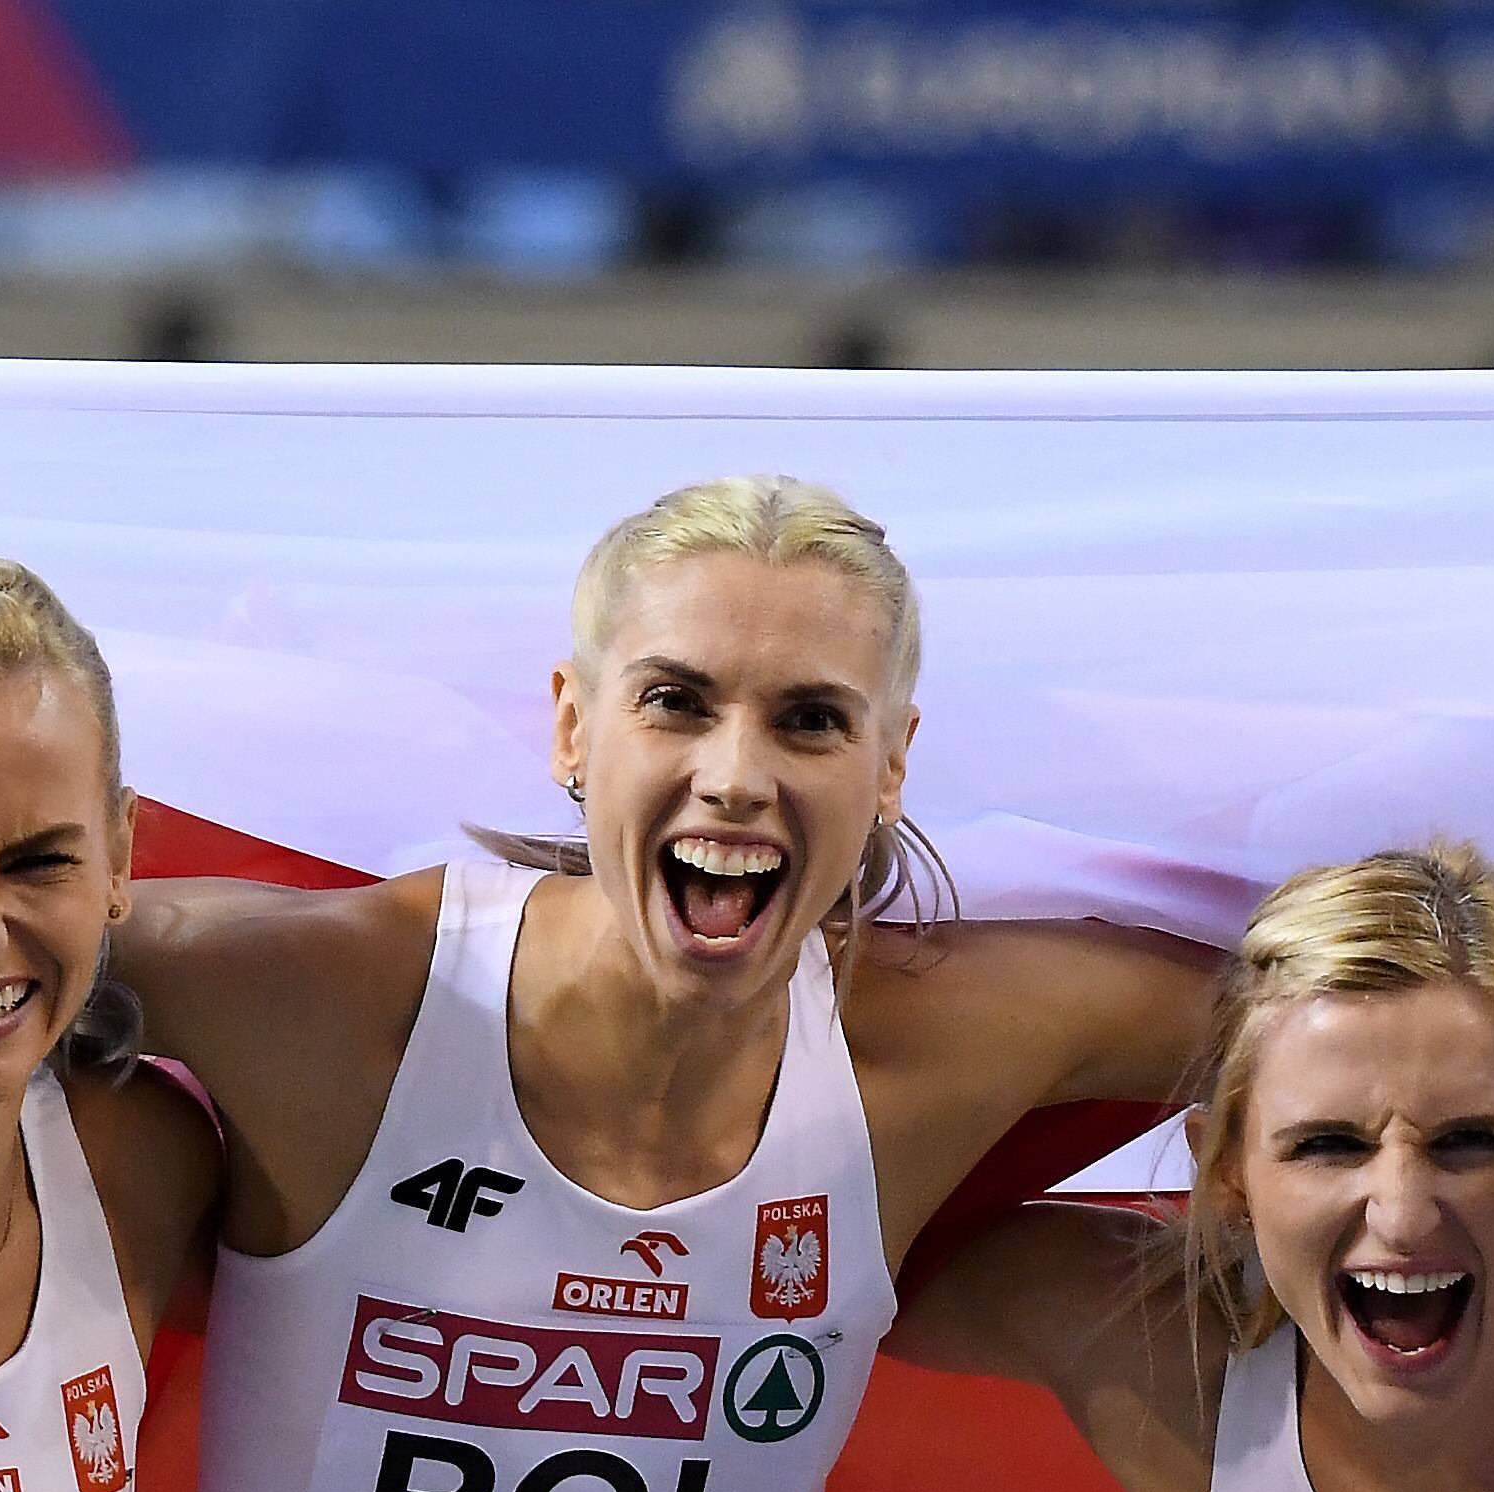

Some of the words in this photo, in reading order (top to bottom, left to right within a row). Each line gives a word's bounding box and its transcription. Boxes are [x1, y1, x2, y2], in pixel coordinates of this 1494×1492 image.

[390, 1157, 526, 1233] 4F
[762, 1202, 823, 1221] POLSKA
[562, 1280, 680, 1314] ORLEN
[65, 1373, 110, 1402] POLSKA
[355, 1318, 705, 1423] SPAR
